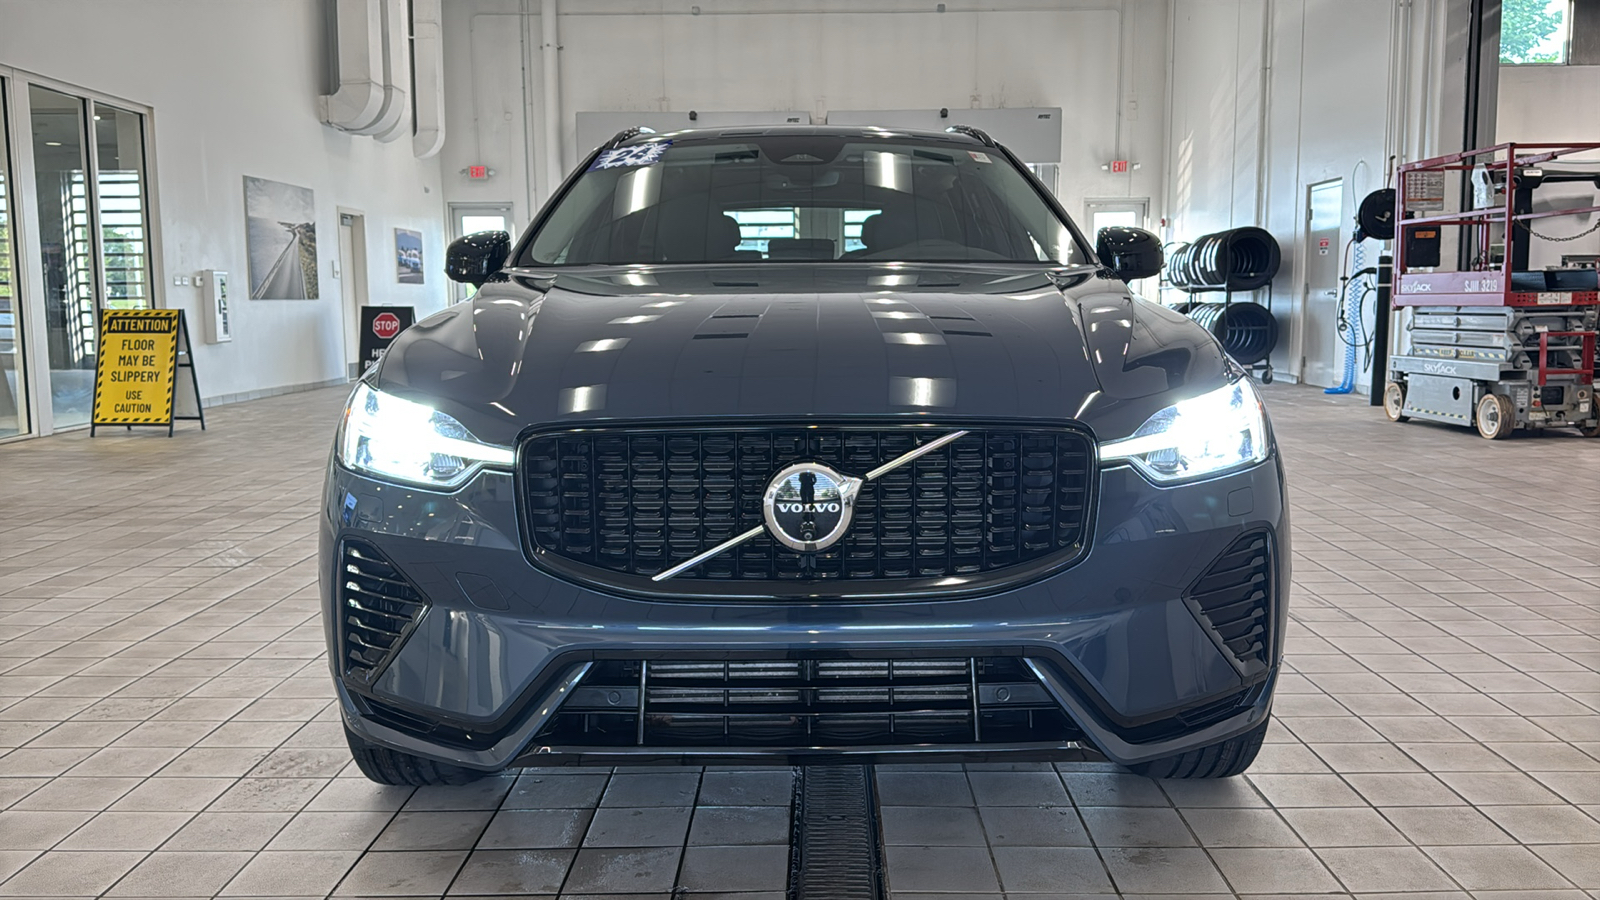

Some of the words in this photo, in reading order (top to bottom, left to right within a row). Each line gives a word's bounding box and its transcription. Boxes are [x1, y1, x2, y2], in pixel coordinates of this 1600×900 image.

[470, 165, 485, 178] EXIT
[1112, 160, 1127, 173] EXIT
[1401, 281, 1431, 293] SKYJACK
[1481, 279, 1498, 292] 3219
[110, 319, 169, 331] ATTENTION
[375, 320, 398, 331] STOP
[121, 339, 155, 351] FLOOR
[118, 355, 139, 366] MAY
[142, 355, 156, 366] BE
[1424, 362, 1457, 375] SKYJACK
[110, 371, 160, 382] SLIPPERY
[125, 390, 142, 400] USE
[114, 403, 152, 413] CAUTION
[776, 503, 840, 513] VOLVO
